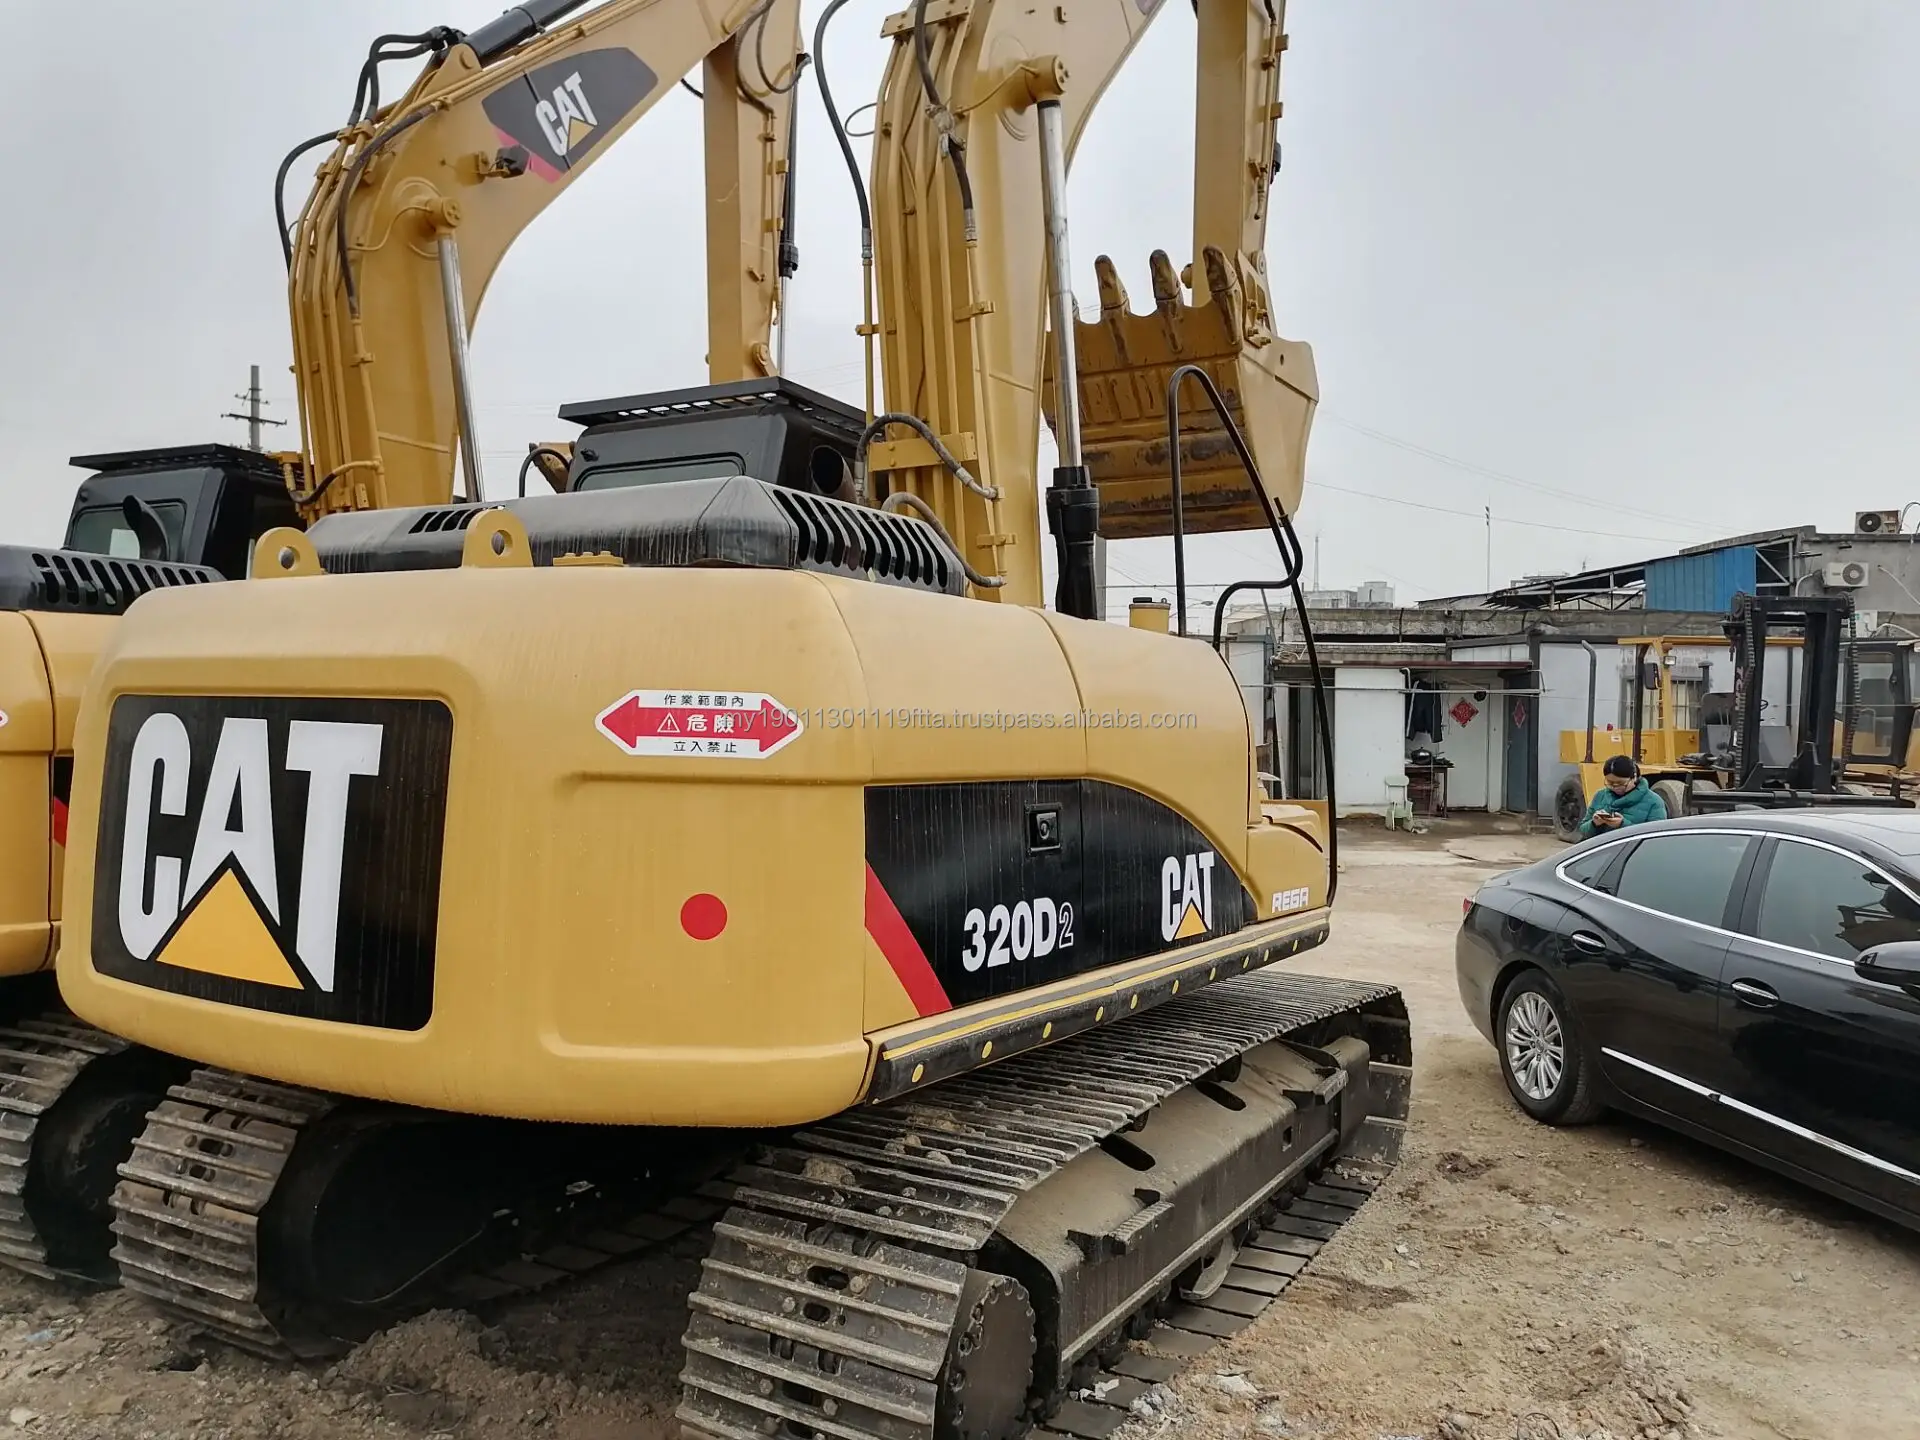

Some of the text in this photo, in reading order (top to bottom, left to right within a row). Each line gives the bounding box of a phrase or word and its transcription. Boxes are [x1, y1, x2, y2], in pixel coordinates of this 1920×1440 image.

[535, 71, 598, 156] CAT
[673, 741, 737, 753] 立入禁止
[687, 714, 734, 734] 危險
[118, 712, 384, 993] CAT
[1161, 851, 1215, 942] CAT
